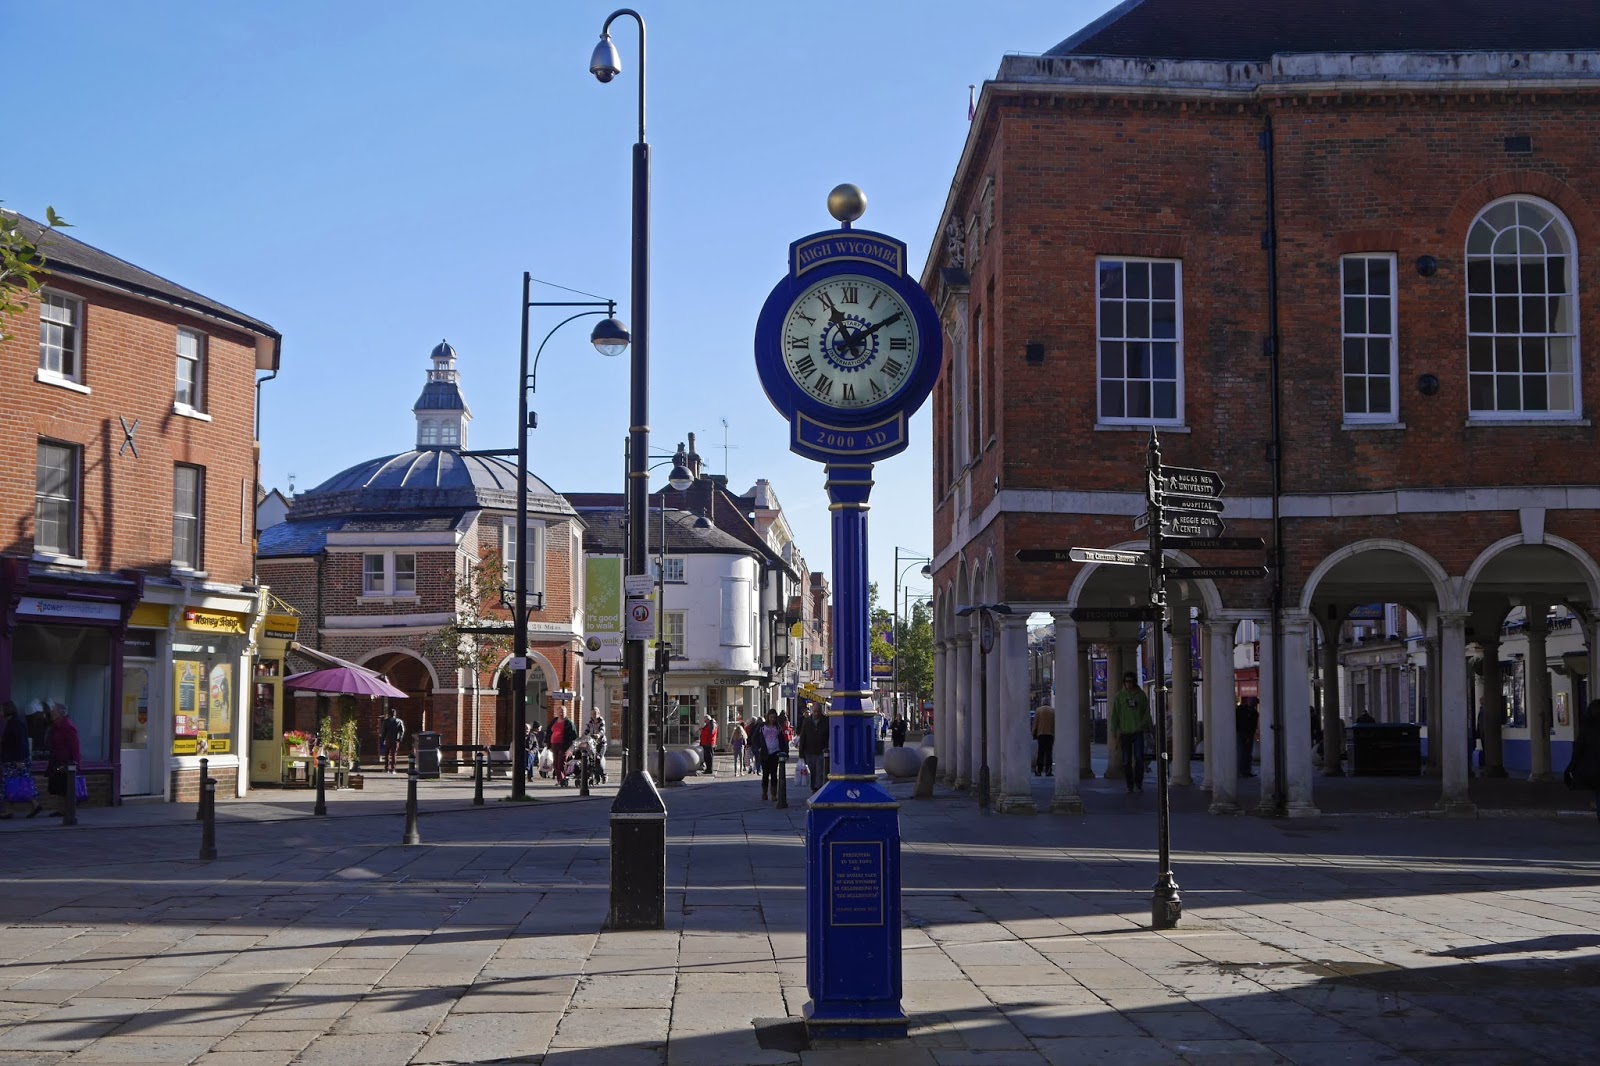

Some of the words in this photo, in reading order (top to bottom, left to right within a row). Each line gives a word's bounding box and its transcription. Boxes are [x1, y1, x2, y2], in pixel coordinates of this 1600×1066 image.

[800, 243, 831, 265] HIGH
[835, 241, 897, 264] WYCOMBE
[841, 287, 859, 304] XII
[890, 337, 906, 351] III
[829, 350, 870, 366] INTERNATIONAL
[816, 432, 854, 448] 2000
[864, 432, 887, 447] AD
[1178, 474, 1198, 482] BUCKS
[1200, 476, 1213, 484] NEW
[1178, 482, 1214, 493] UNIVERSITY
[1181, 502, 1212, 510] HOSPITAL
[1180, 516, 1199, 524] REGGIE
[1180, 525, 1201, 534] CENTRE
[598, 613, 618, 623] good
[587, 622, 595, 630] to
[596, 621, 614, 630] walk
